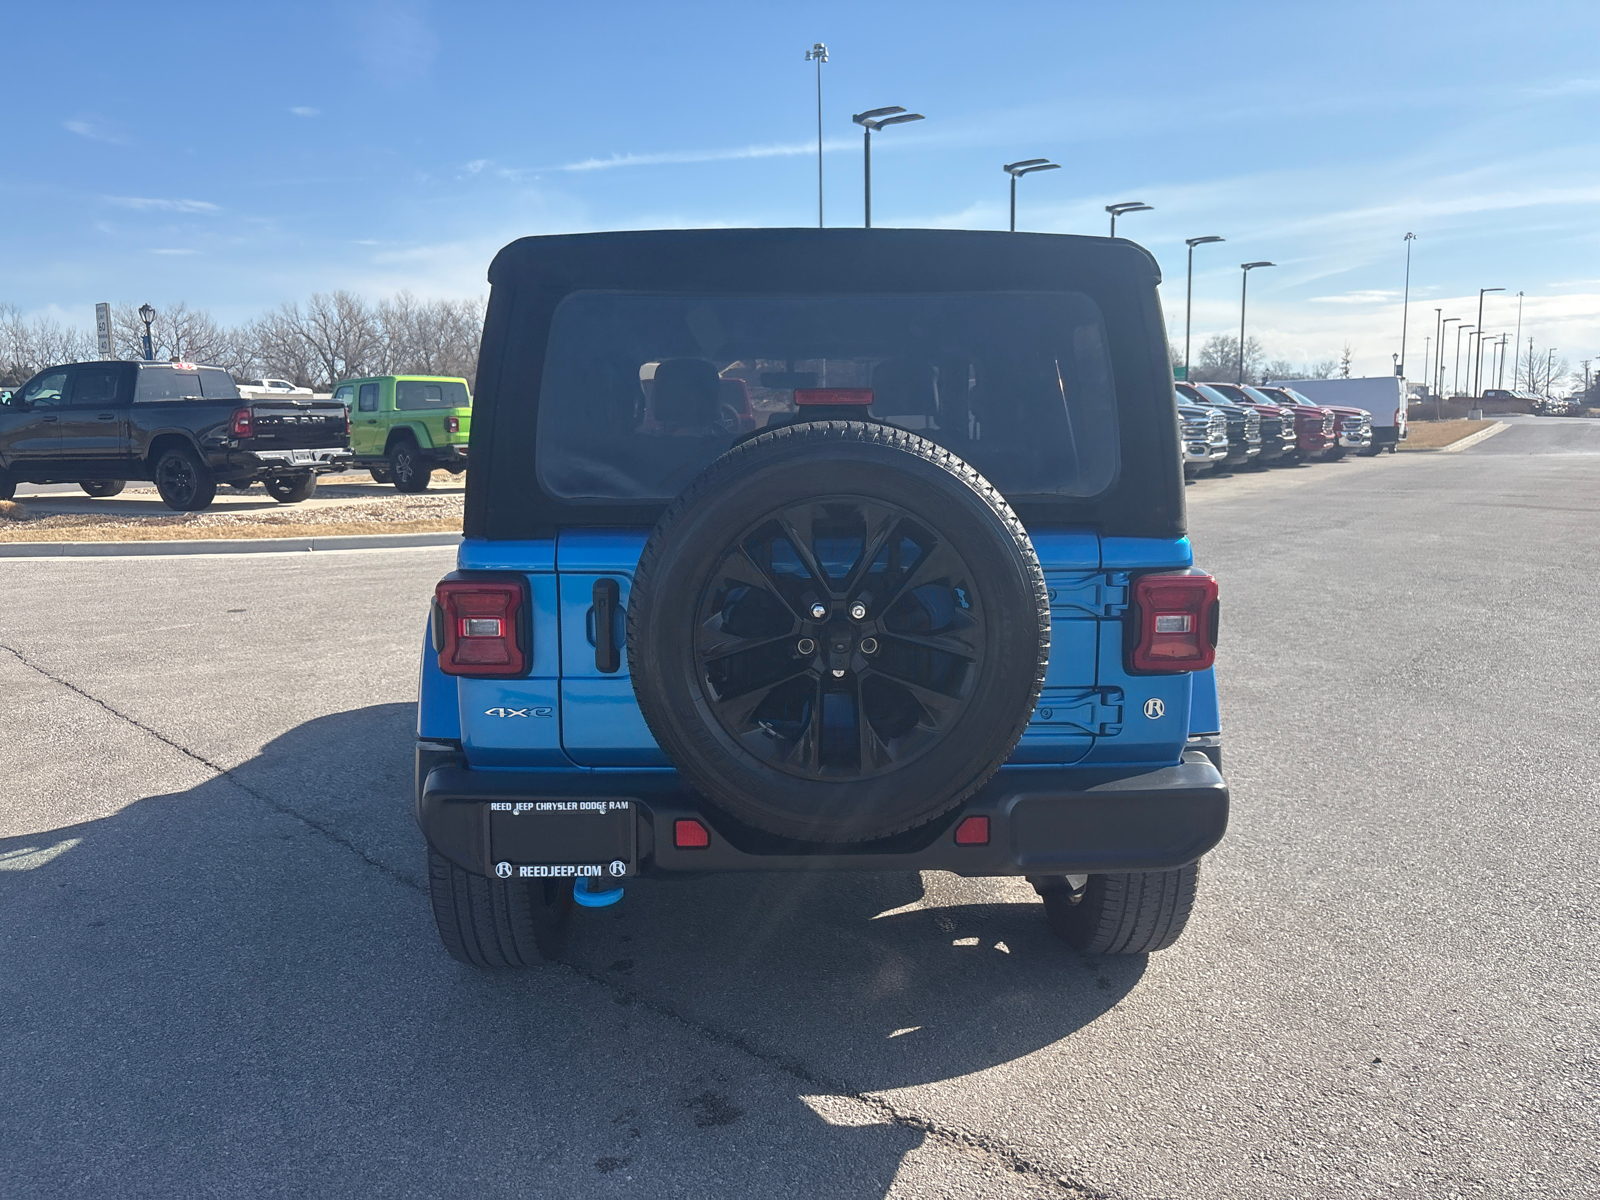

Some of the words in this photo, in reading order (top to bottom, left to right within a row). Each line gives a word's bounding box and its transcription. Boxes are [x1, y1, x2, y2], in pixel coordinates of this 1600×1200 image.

[282, 416, 326, 426] RAM
[490, 802, 512, 811] REED
[515, 802, 534, 811] JEEP
[536, 802, 578, 811] CHRYSLER
[580, 801, 607, 810] DODGE
[609, 801, 629, 810] RAM
[519, 865, 602, 877] REEDJEEP.COM
